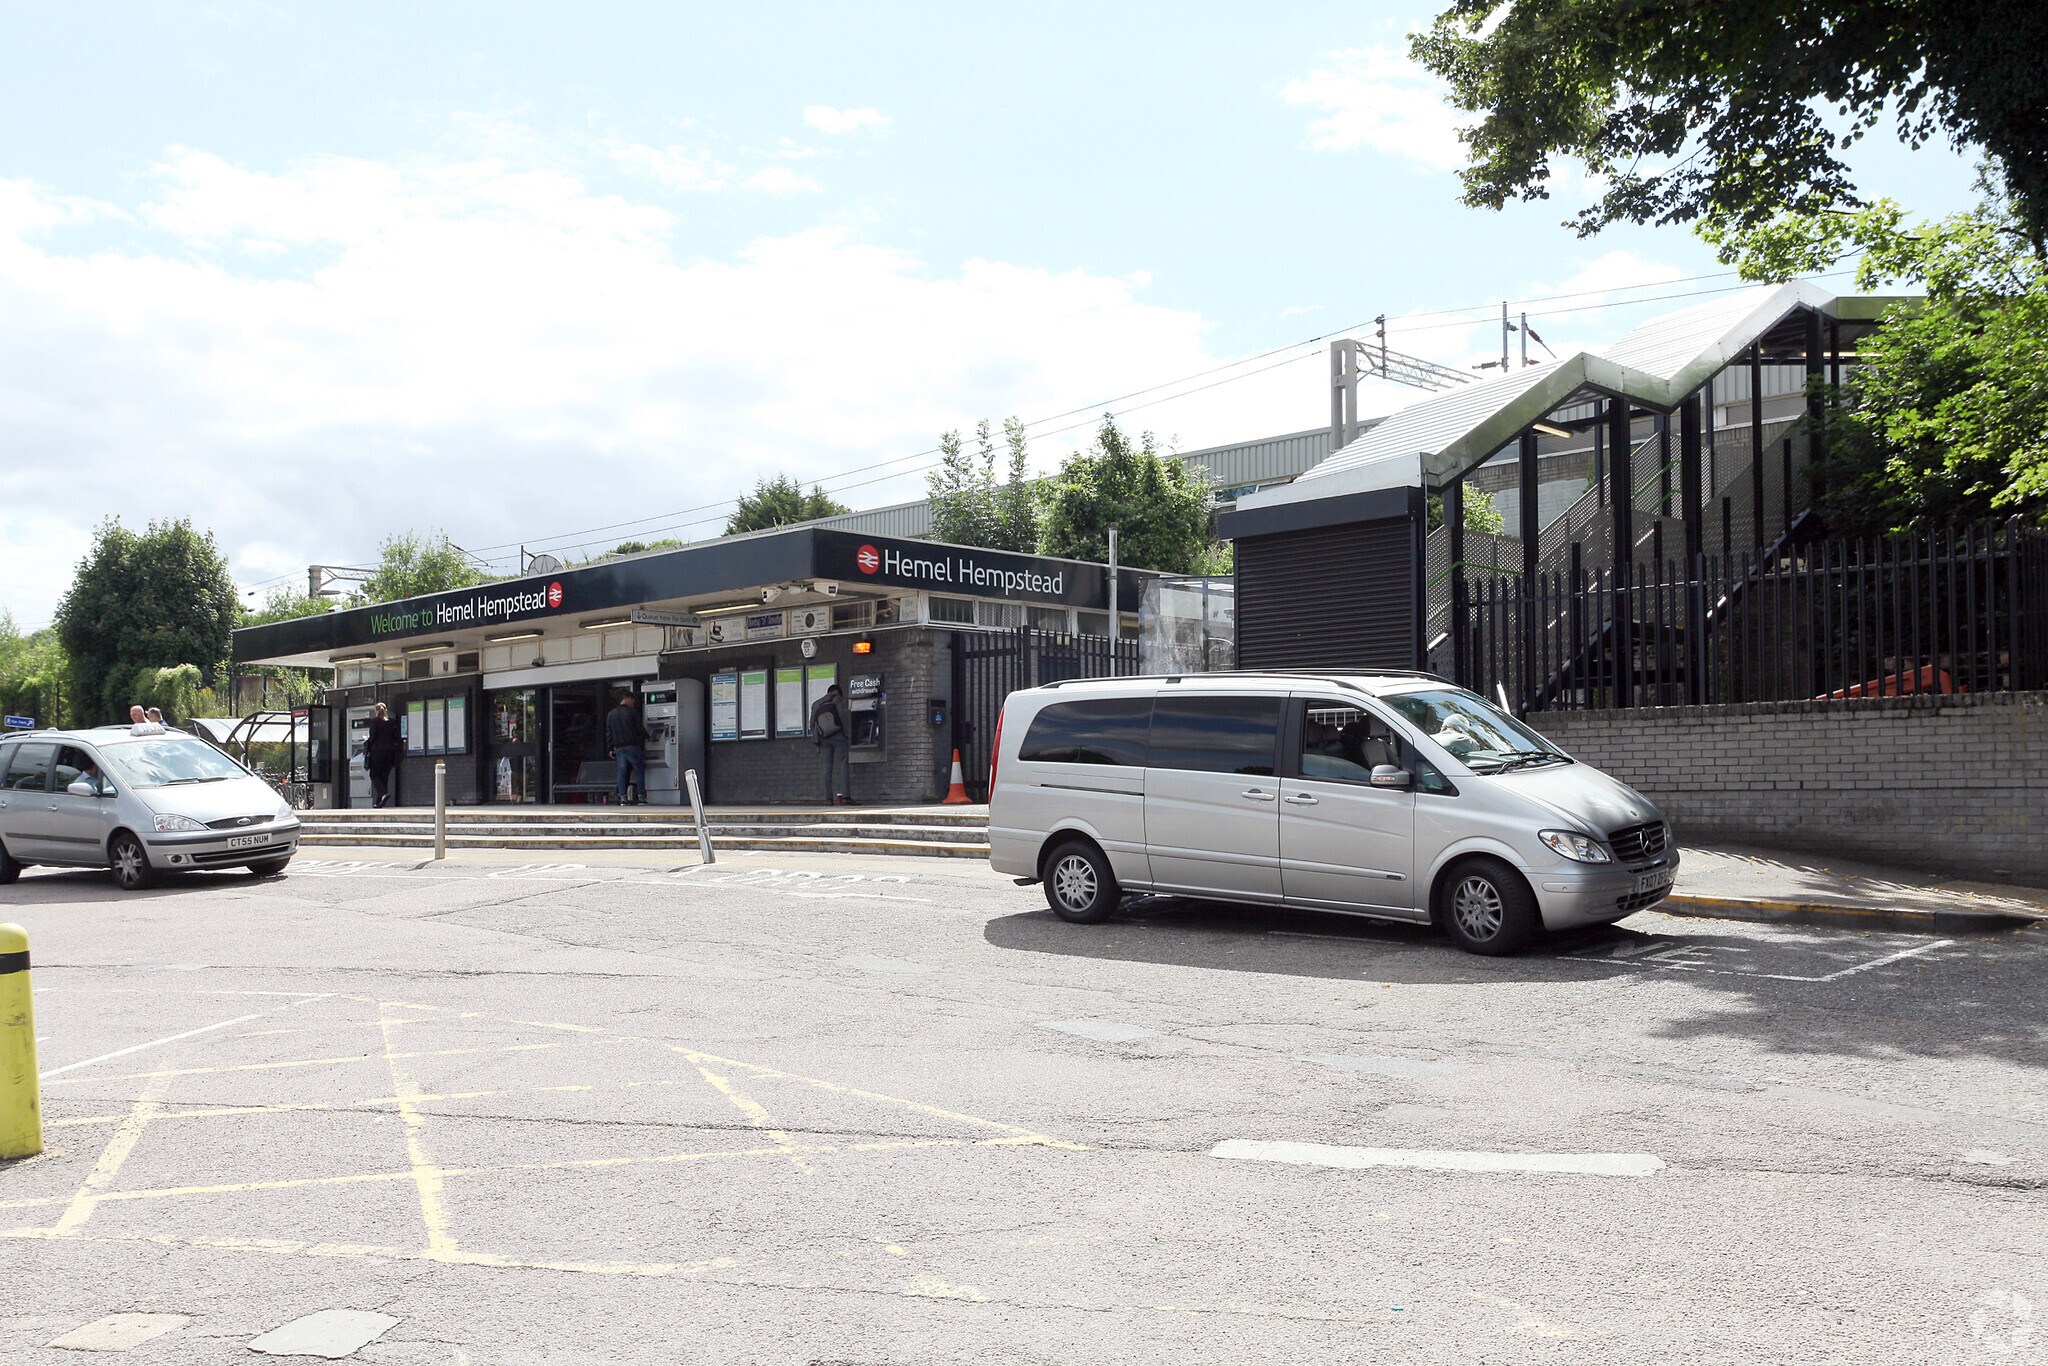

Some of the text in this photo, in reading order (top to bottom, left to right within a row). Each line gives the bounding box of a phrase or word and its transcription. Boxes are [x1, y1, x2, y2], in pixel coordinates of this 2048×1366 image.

[884, 549, 1063, 595] Hemel Hempstead
[370, 585, 547, 634] Welcome to Hemel Hempstead
[850, 678, 880, 688] Free Cash
[230, 834, 269, 847] CT55 NUM
